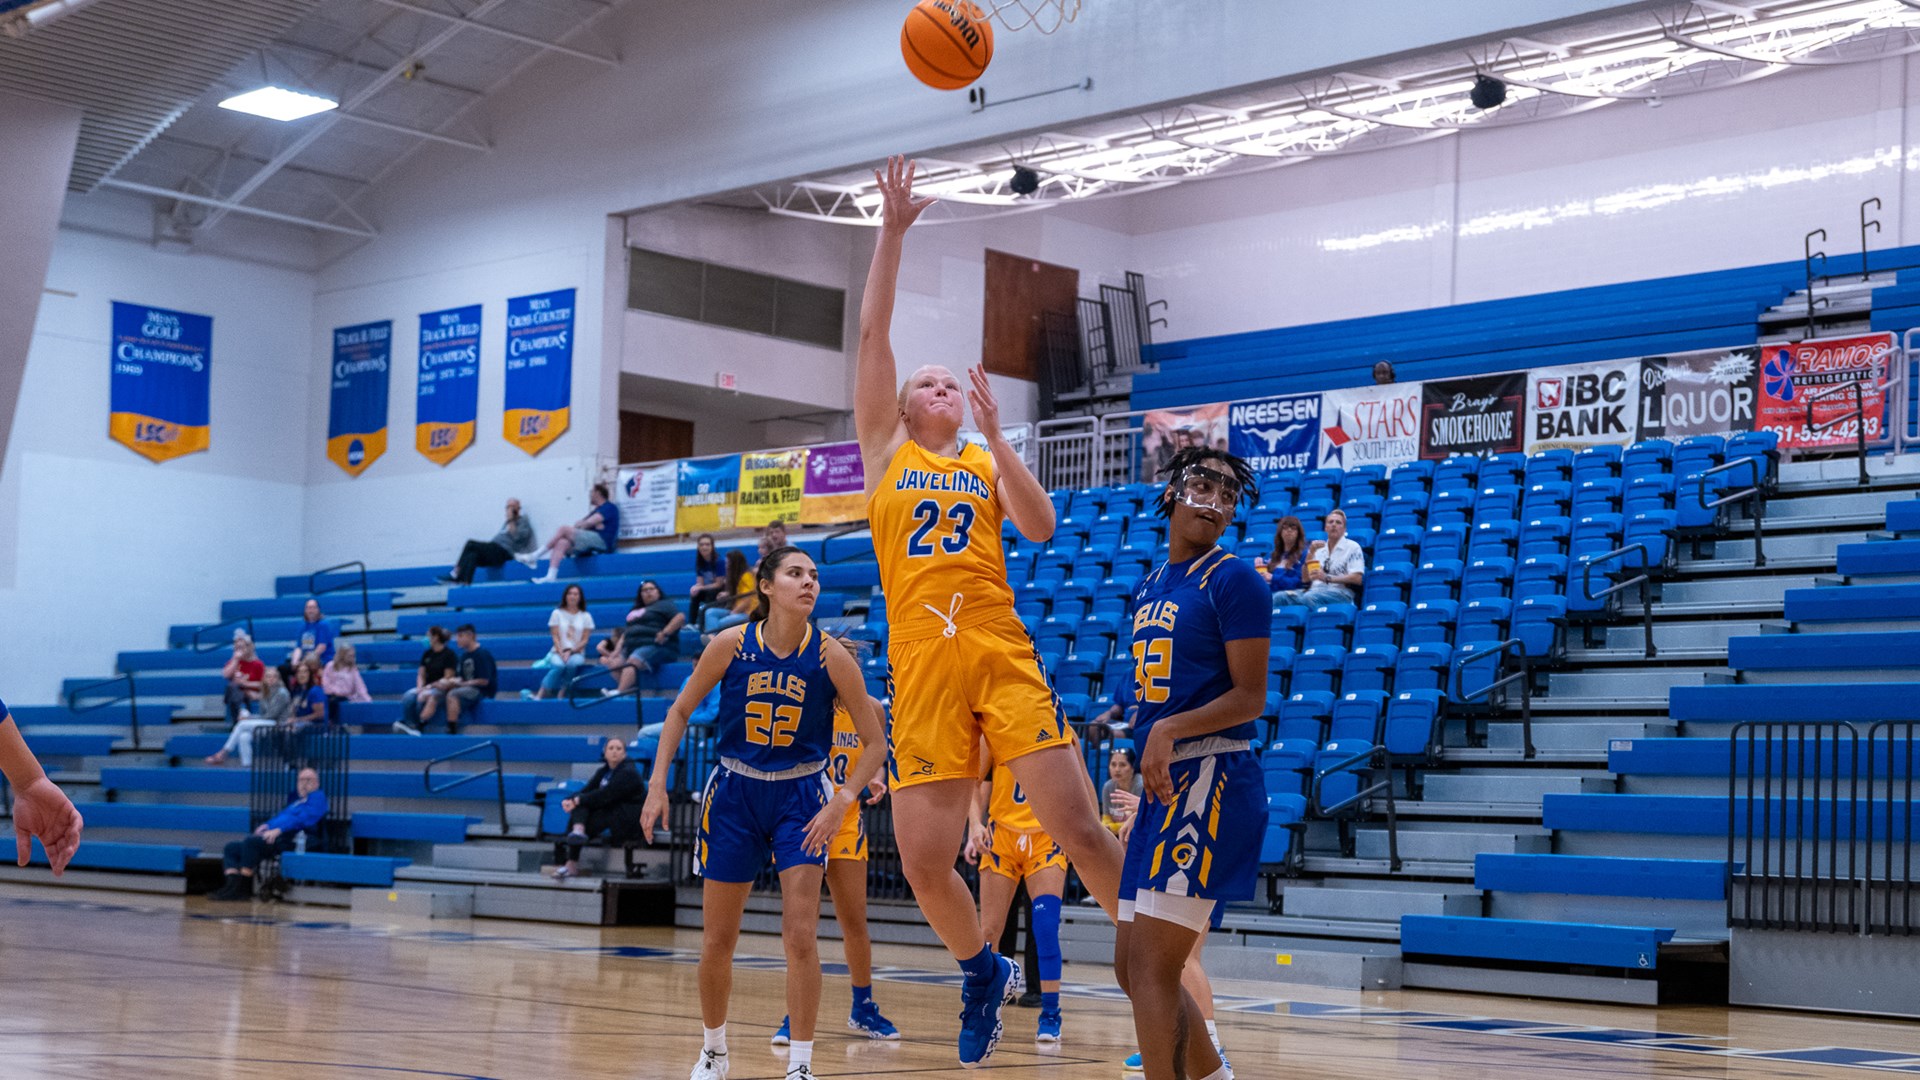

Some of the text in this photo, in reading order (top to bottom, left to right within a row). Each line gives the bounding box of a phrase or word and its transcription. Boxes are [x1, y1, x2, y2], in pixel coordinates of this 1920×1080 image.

[141, 321, 183, 341] GOLF
[117, 341, 203, 372] CHAMPIONS
[1794, 342, 1888, 373] RAMOS
[1564, 370, 1627, 408] IBC
[1231, 398, 1319, 426] NEESSEN
[1353, 395, 1418, 441] STARS
[1536, 405, 1628, 441] BANK
[1642, 387, 1753, 428] LIQUOR
[1430, 410, 1514, 447] SMOKEHOUSE
[1352, 438, 1416, 461] SOUTH TEXAS
[740, 491, 770, 505] RANCH
[781, 488, 800, 503] FEED
[896, 468, 990, 500] JAVELINAS
[907, 498, 976, 558] 23
[746, 671, 806, 703] BELLES
[745, 700, 803, 749] 22
